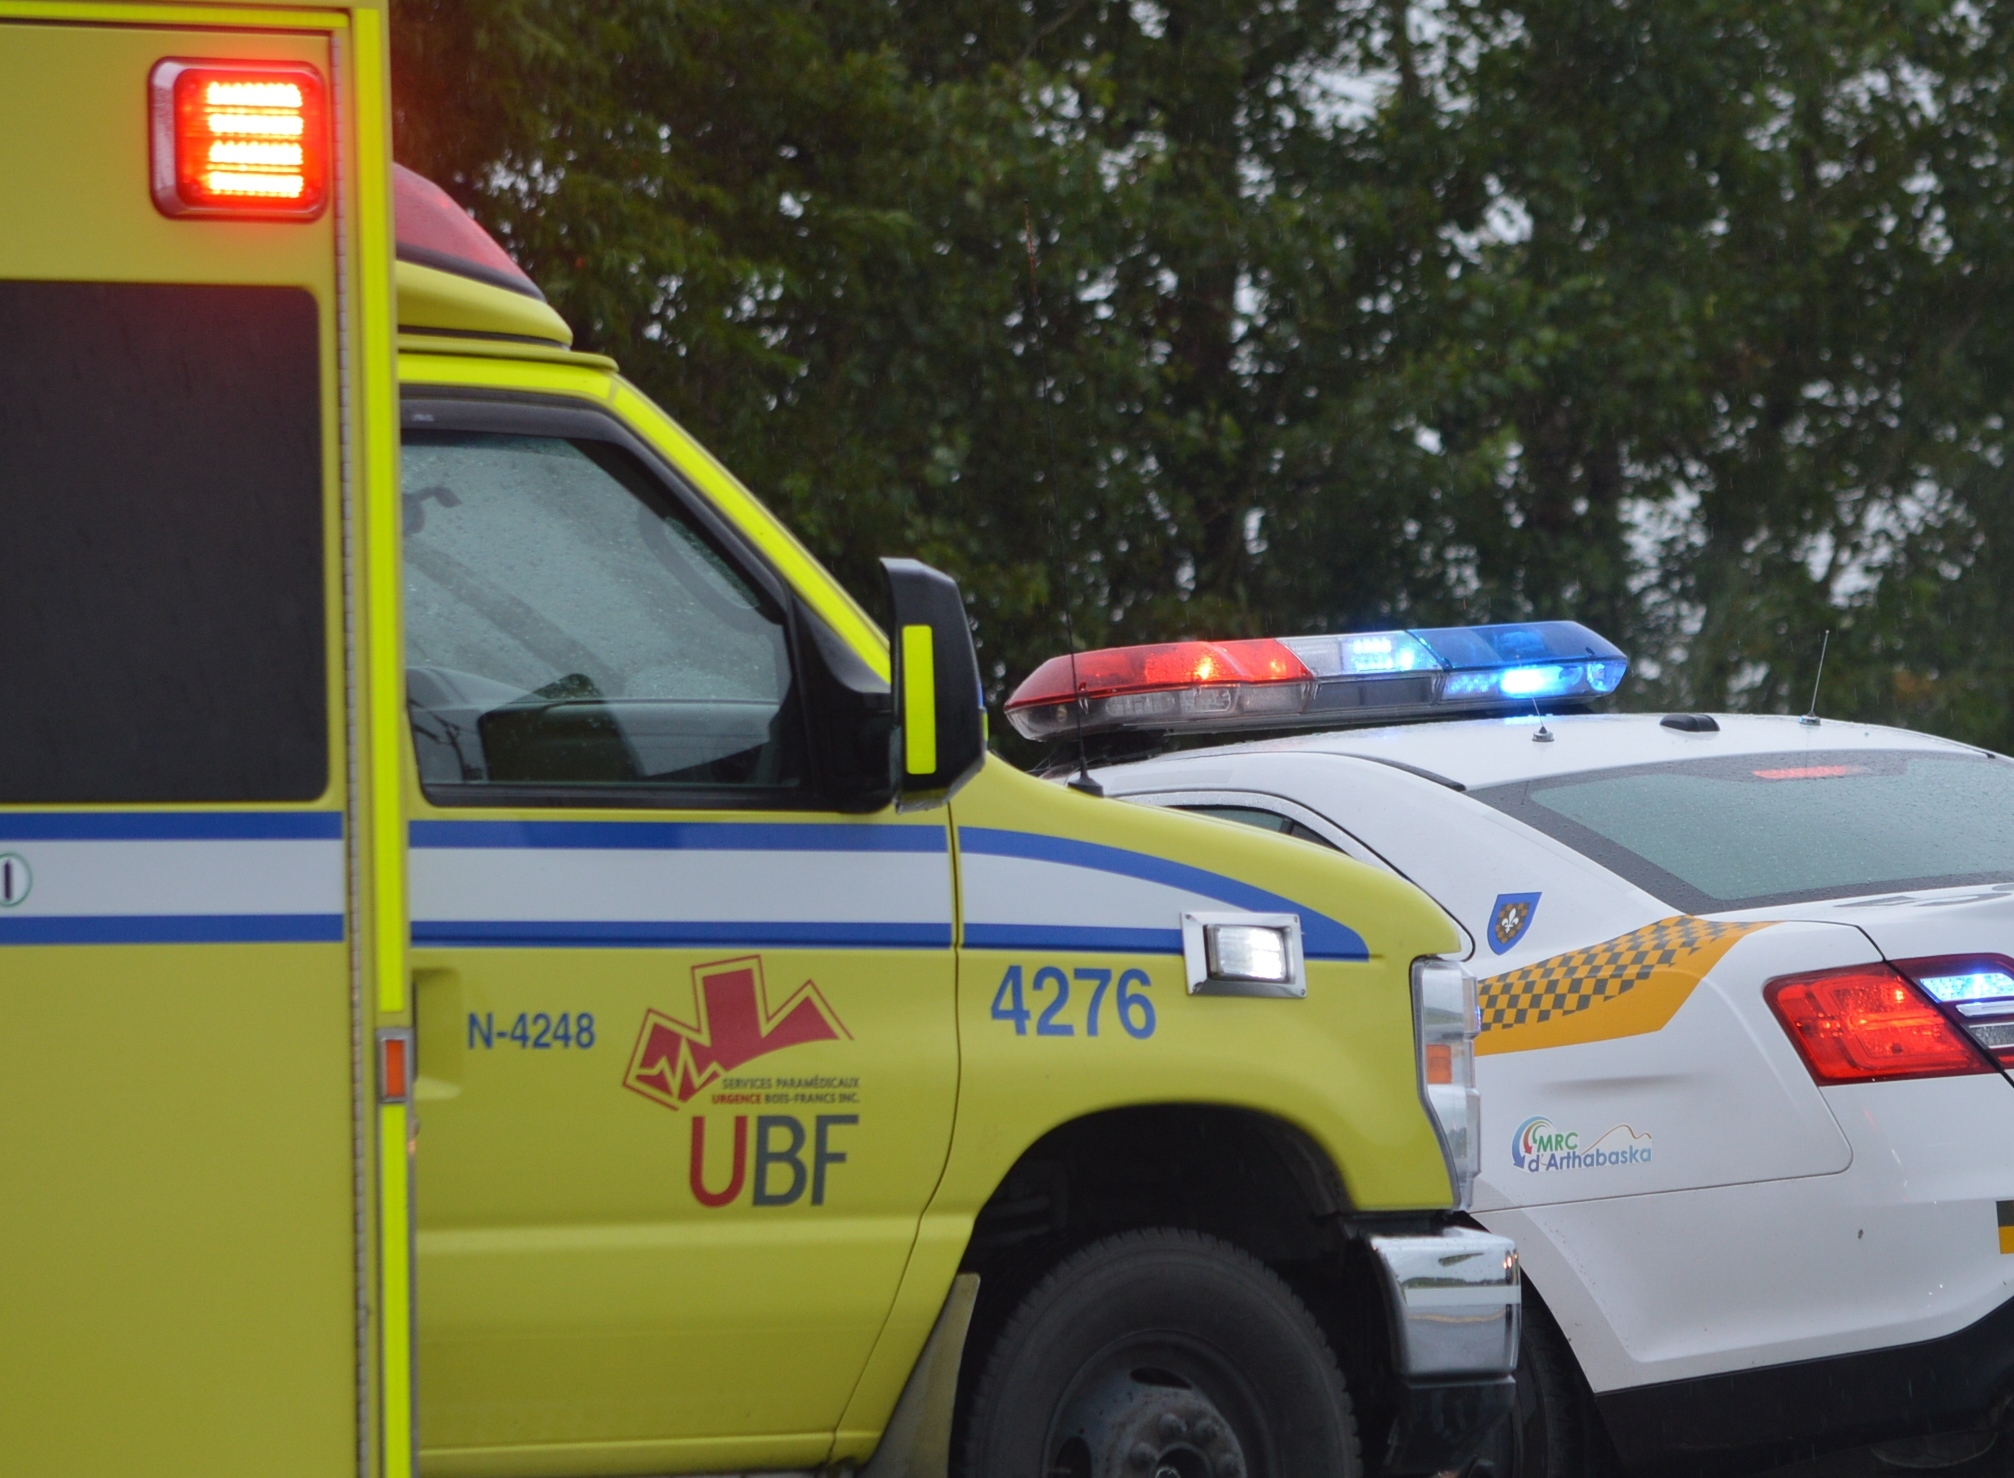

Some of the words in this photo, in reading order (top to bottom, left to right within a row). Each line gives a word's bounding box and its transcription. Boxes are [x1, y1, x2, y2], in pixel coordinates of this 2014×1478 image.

[991, 965, 1156, 1040] 4276
[468, 1012, 594, 1049] N-4248
[722, 1077, 773, 1090] SERVICES
[776, 1074, 860, 1089] PARAMÉDICAUX
[711, 1094, 762, 1104] URGENCE
[765, 1093, 836, 1104] BOIS-FRANCS
[1537, 1132, 1578, 1153] MRC
[690, 1114, 859, 1207] UBF
[1528, 1145, 1651, 1173] d'Arthabaska
